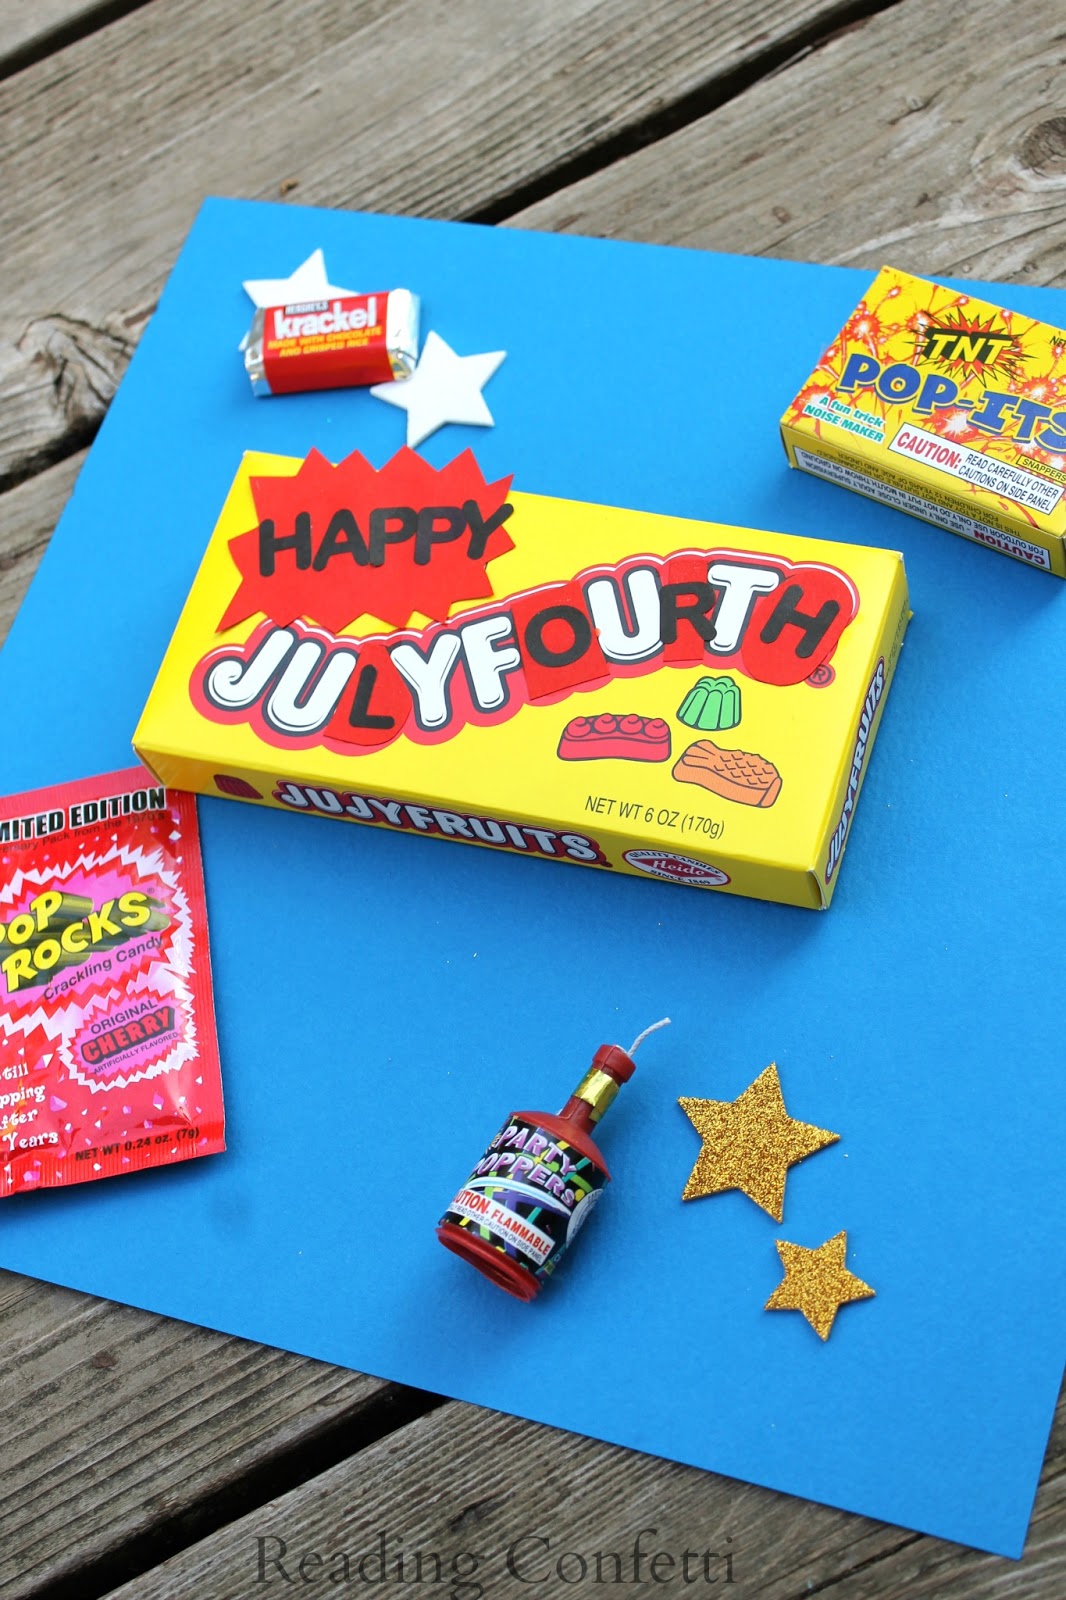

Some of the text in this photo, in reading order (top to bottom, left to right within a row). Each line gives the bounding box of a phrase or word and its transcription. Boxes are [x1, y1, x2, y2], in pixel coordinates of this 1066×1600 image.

[274, 297, 377, 340] krackel
[267, 326, 382, 350] MADE WITH CHOCOLATE
[928, 334, 1013, 365] TNT
[279, 347, 301, 358] AND
[819, 396, 884, 427] A fun trick
[836, 353, 1066, 454] POP-ITS
[804, 405, 884, 442] NOISE MAKER
[896, 431, 963, 470] CAUTION:
[832, 465, 843, 474] ON
[965, 453, 1059, 500] READ CAREFULLY OTHER
[853, 481, 875, 494] ADULT
[908, 496, 921, 505] PUT
[958, 465, 1051, 511] CAUTIONS ON SIDE PANEL
[902, 501, 927, 516] UNDER
[924, 502, 938, 512] NOT
[929, 512, 948, 525] ONLY
[944, 496, 982, 515] CHILDREN
[955, 506, 969, 516] TOY
[983, 511, 999, 522] FOR
[950, 521, 965, 532] USE
[974, 522, 989, 533] USE
[980, 517, 994, 526] NOT
[1004, 526, 1021, 537] THIS
[258, 499, 514, 577] HAPPY
[974, 530, 1045, 565] CAUTION
[990, 531, 1026, 549] OUTDOOR
[1028, 545, 1044, 556] FOR
[70, 788, 166, 828] EDITION
[584, 795, 725, 840] NET WT 6 OZ (170g)
[42, 832, 70, 846] Pack
[74, 825, 100, 837] from
[103, 820, 122, 830] the
[279, 782, 600, 862] JUJYFRUITS
[629, 850, 669, 858] QUALITY
[651, 869, 685, 883] SINCE
[653, 860, 705, 876] Heide
[1, 891, 151, 994] ROCKS
[43, 935, 163, 1001] Crackling Candy
[91, 999, 158, 1034] ORIGINAL
[82, 1007, 173, 1064] CHERRY
[93, 1032, 179, 1074] ARTIFICIALLY FLAVORED
[0, 1062, 29, 1080] till
[2, 1131, 58, 1151] Years
[75, 1127, 199, 1161] NET WT 0.24 oz. (7g)
[495, 1126, 577, 1176] PARTY
[453, 1190, 489, 1214] UTION.
[491, 1209, 551, 1256] FLAMMABLE
[484, 1218, 509, 1238] CAUTION
[508, 1233, 517, 1243] ON
[516, 1239, 529, 1252] SIDE
